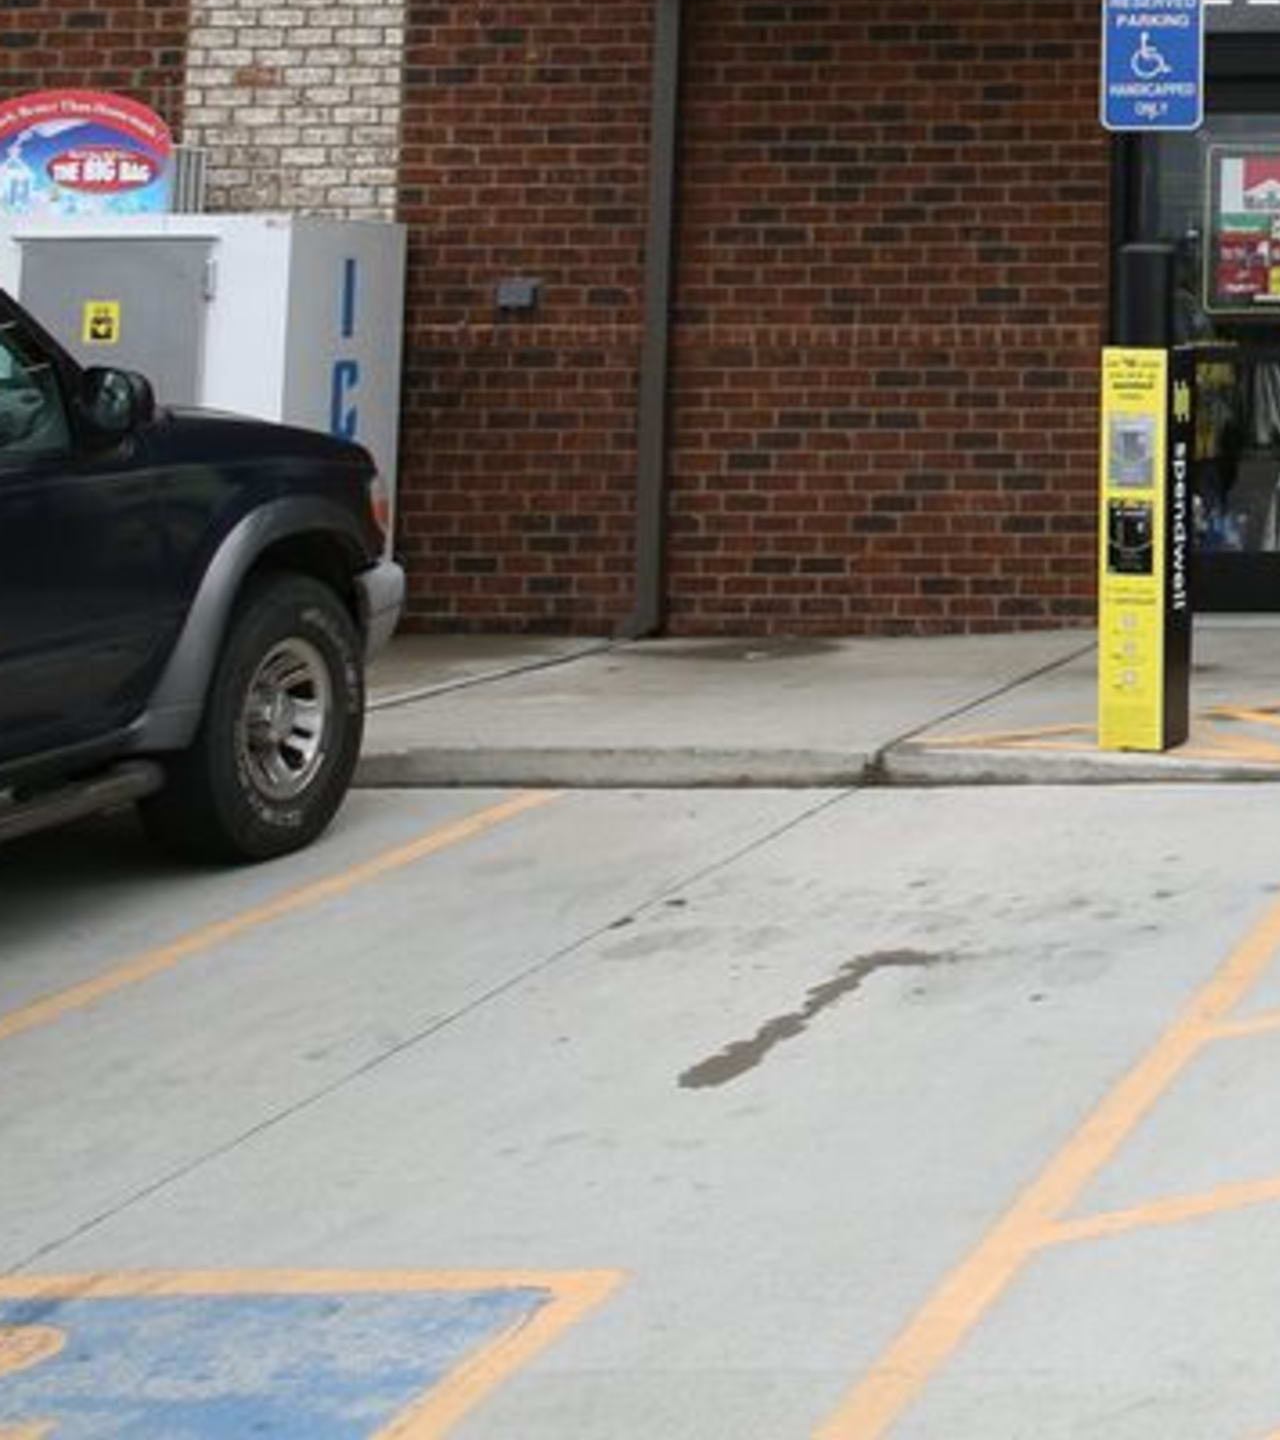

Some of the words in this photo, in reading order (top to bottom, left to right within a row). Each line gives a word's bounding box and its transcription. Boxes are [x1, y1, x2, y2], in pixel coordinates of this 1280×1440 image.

[1114, 13, 1190, 28] PARKING
[1109, 81, 1197, 97] HANDICAPPED
[1173, 441, 1187, 610] spendwell
